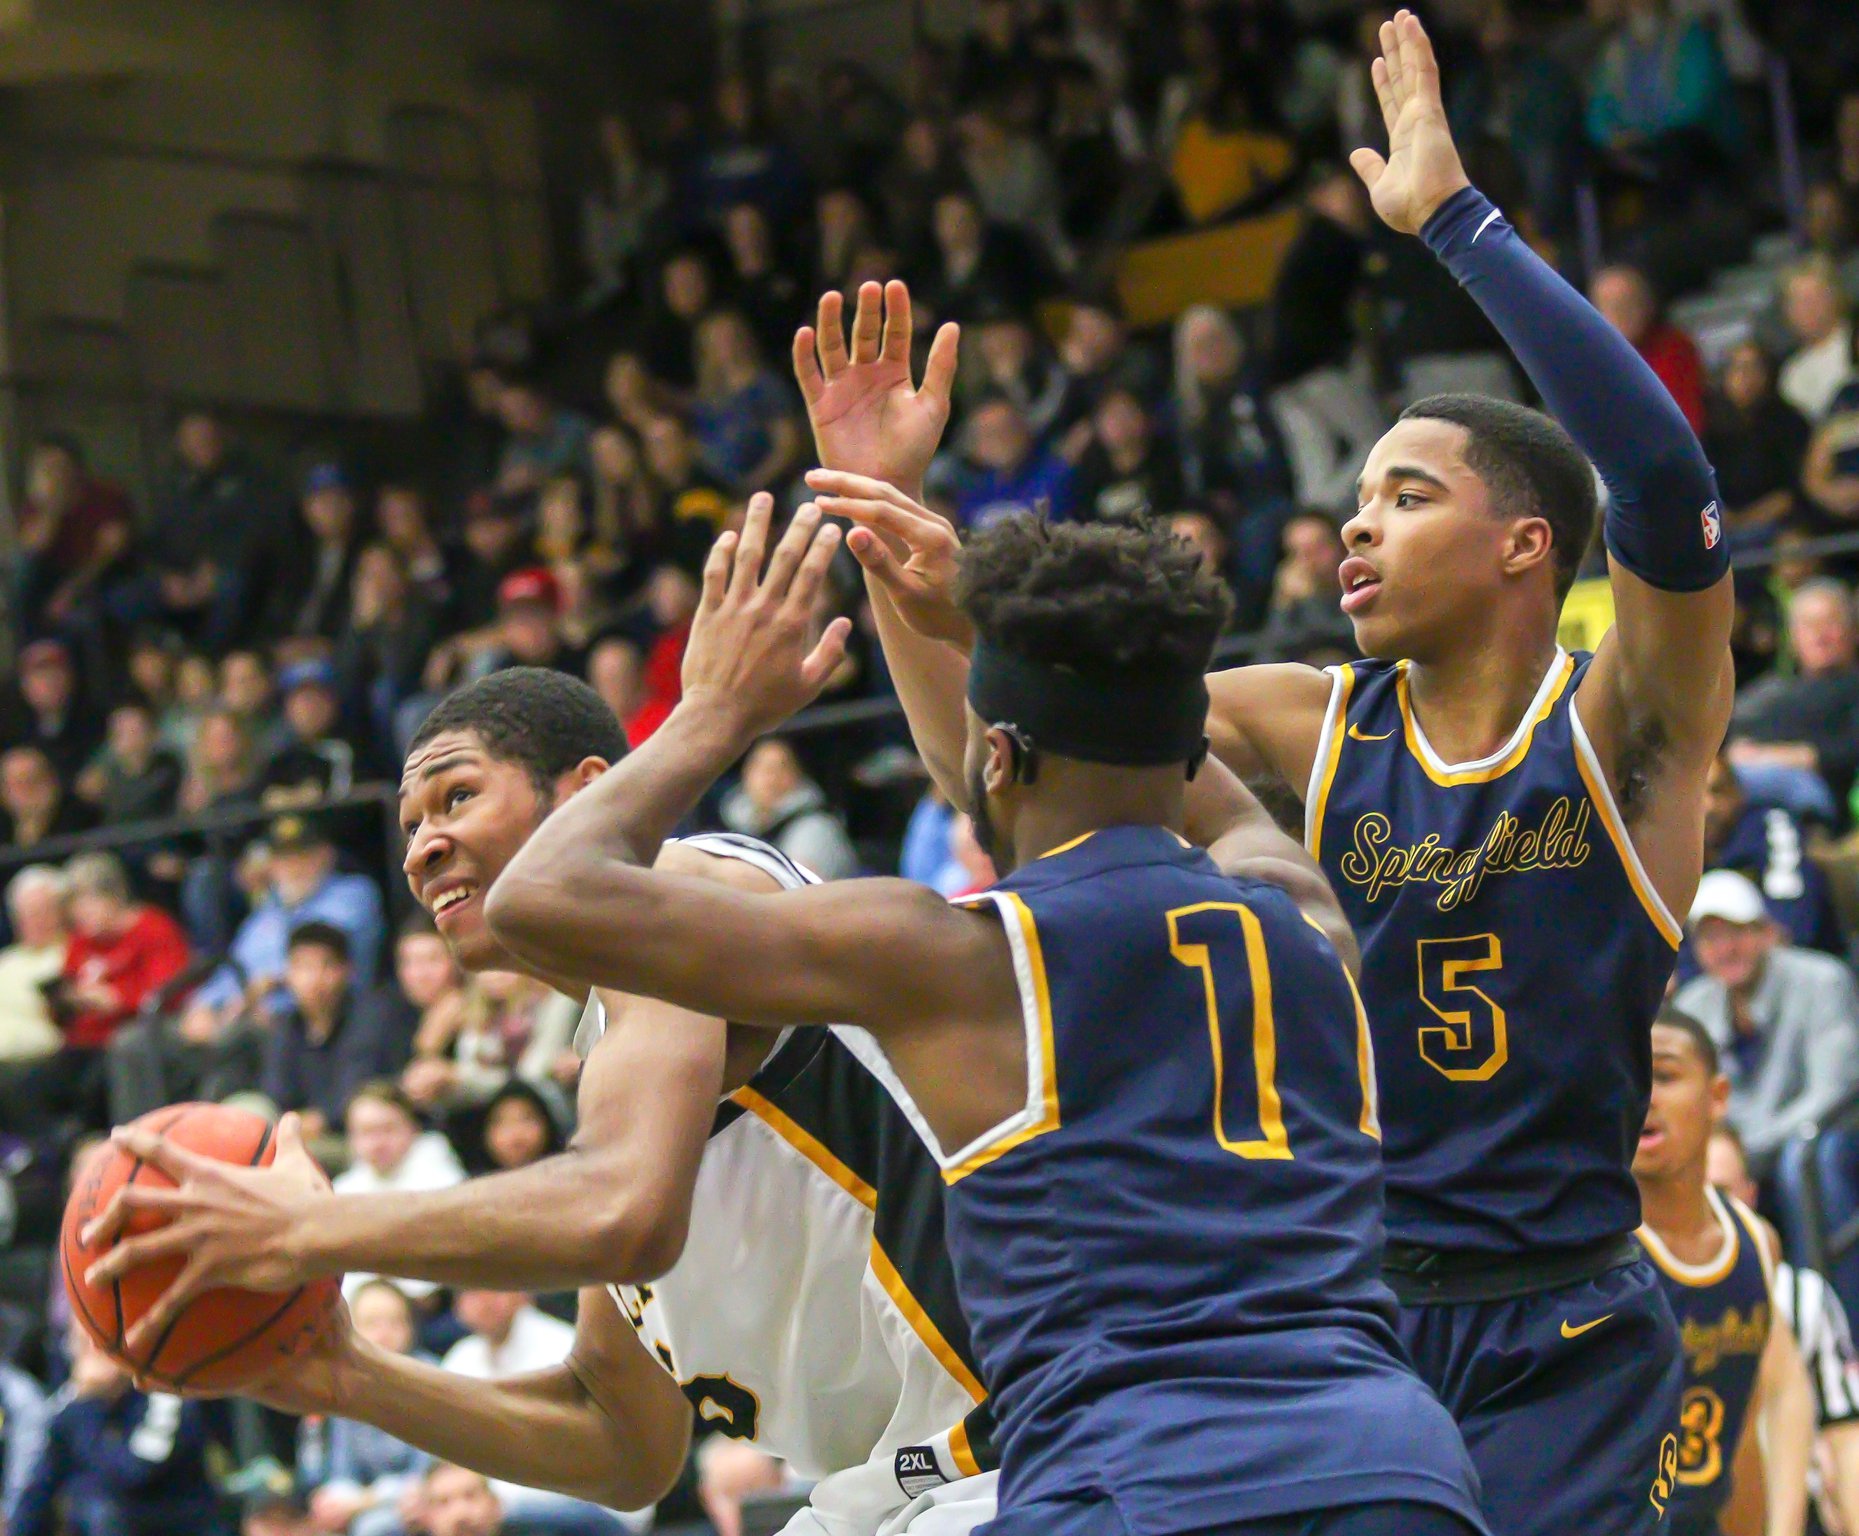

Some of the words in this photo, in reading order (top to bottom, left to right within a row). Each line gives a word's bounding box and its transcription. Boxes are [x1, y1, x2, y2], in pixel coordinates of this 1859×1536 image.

[1341, 797, 1590, 912] Spingfield
[1165, 901, 1295, 1160] 1
[1416, 933, 1508, 1081] 5
[899, 1453, 933, 1471] 2XL
